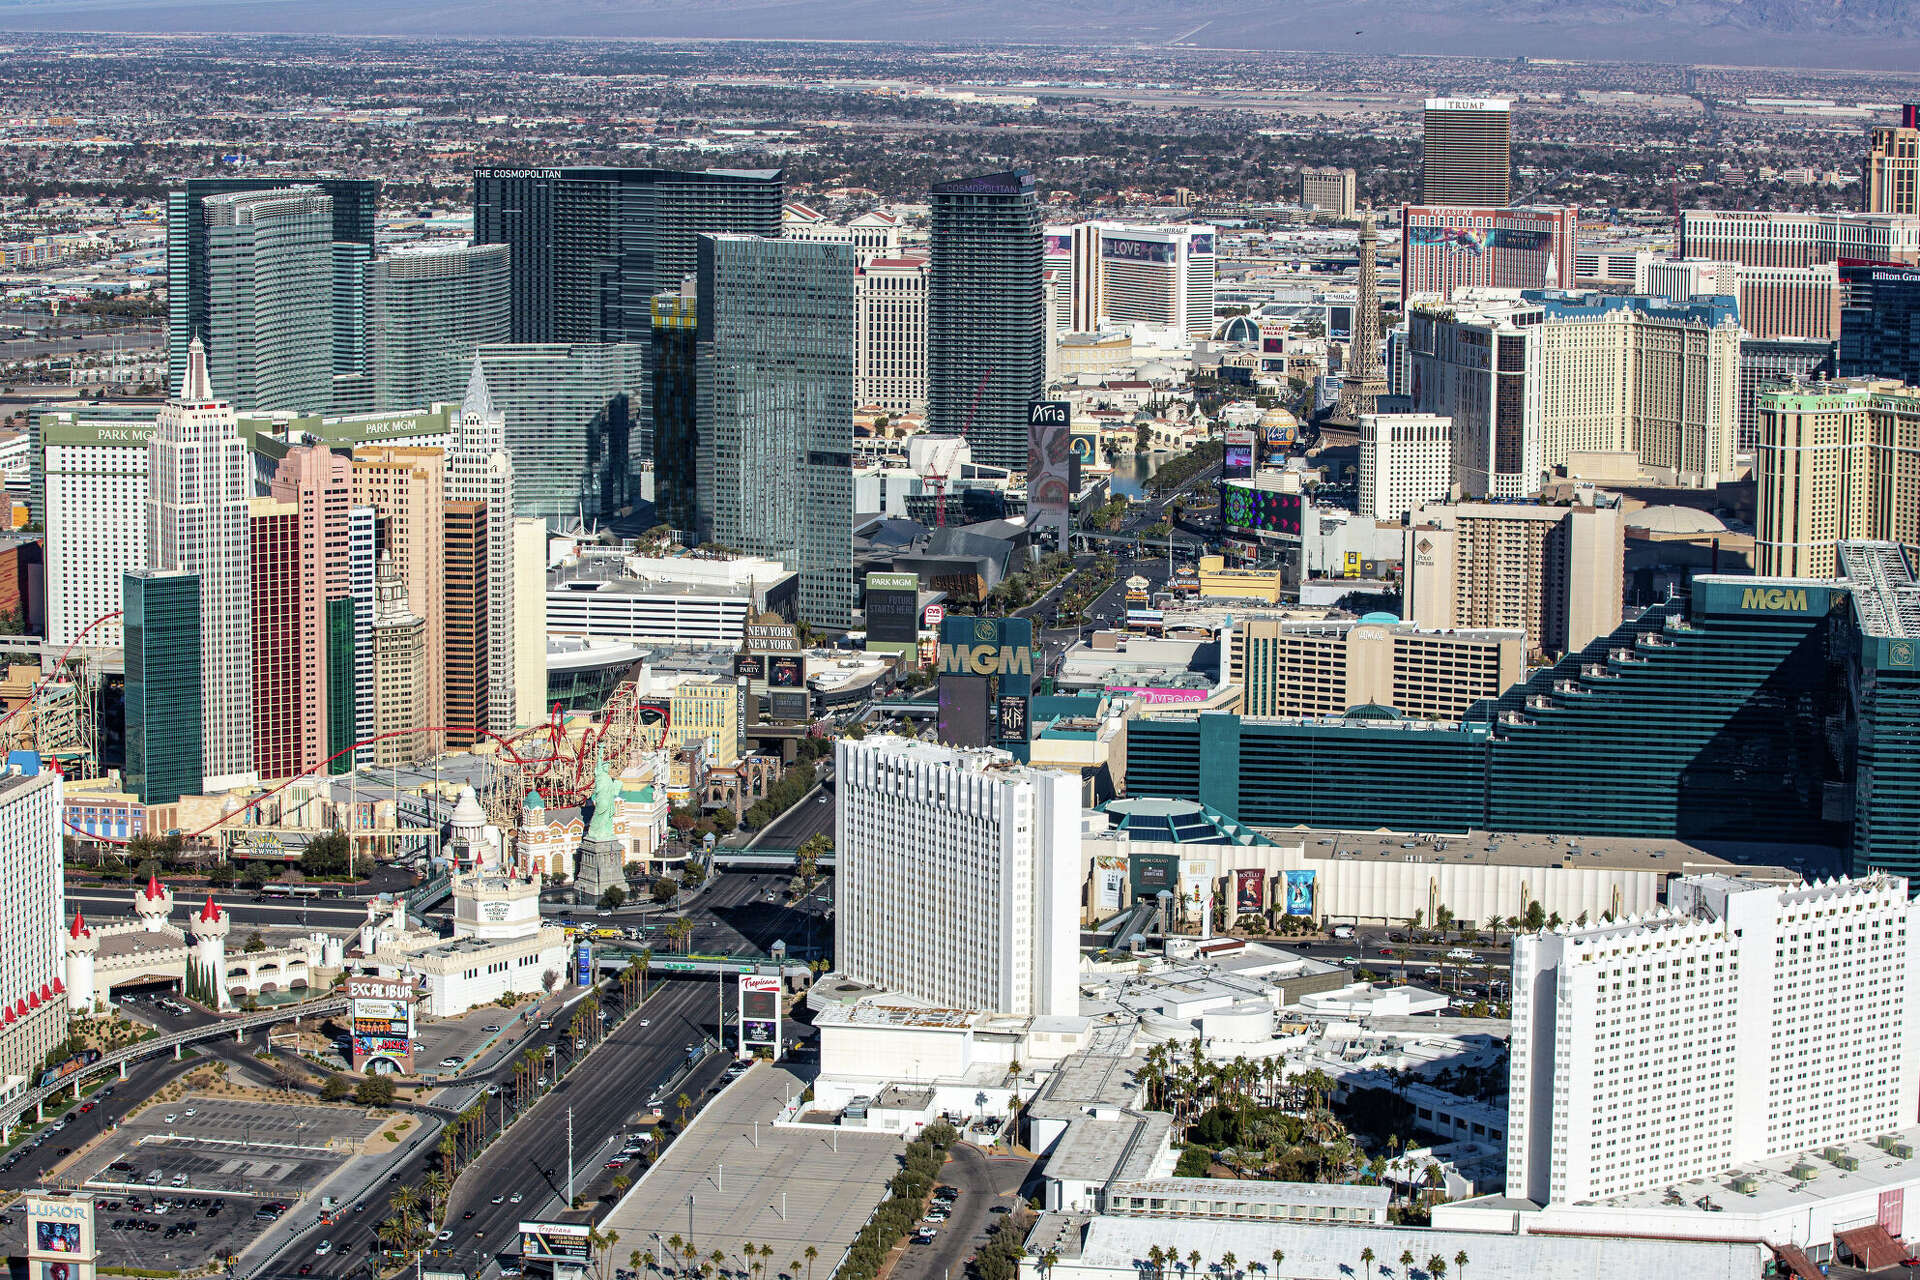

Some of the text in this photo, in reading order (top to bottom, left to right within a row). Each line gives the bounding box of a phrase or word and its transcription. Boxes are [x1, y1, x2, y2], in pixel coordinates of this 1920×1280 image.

[1448, 101, 1485, 109] TRUMP
[474, 169, 561, 178] THE COSMOPOLITAN
[947, 184, 1017, 193] COSMOPOLITAN
[1715, 212, 1769, 221] VENETIAN
[1114, 241, 1141, 257] LOVE
[1872, 271, 1900, 281] Hilton
[1032, 404, 1065, 423] Aria
[366, 419, 416, 434] PARK MGM
[97, 429, 129, 441] PARK
[871, 578, 912, 587] PARK MGM
[1741, 588, 1808, 611] MGM
[748, 626, 793, 637] NEW YORK
[748, 639, 793, 650] NEW YORK
[938, 644, 1032, 675] MGM
[741, 977, 777, 989] Tropicana
[351, 983, 413, 998] EXCALIBUR
[27, 1204, 87, 1220] LUXOR
